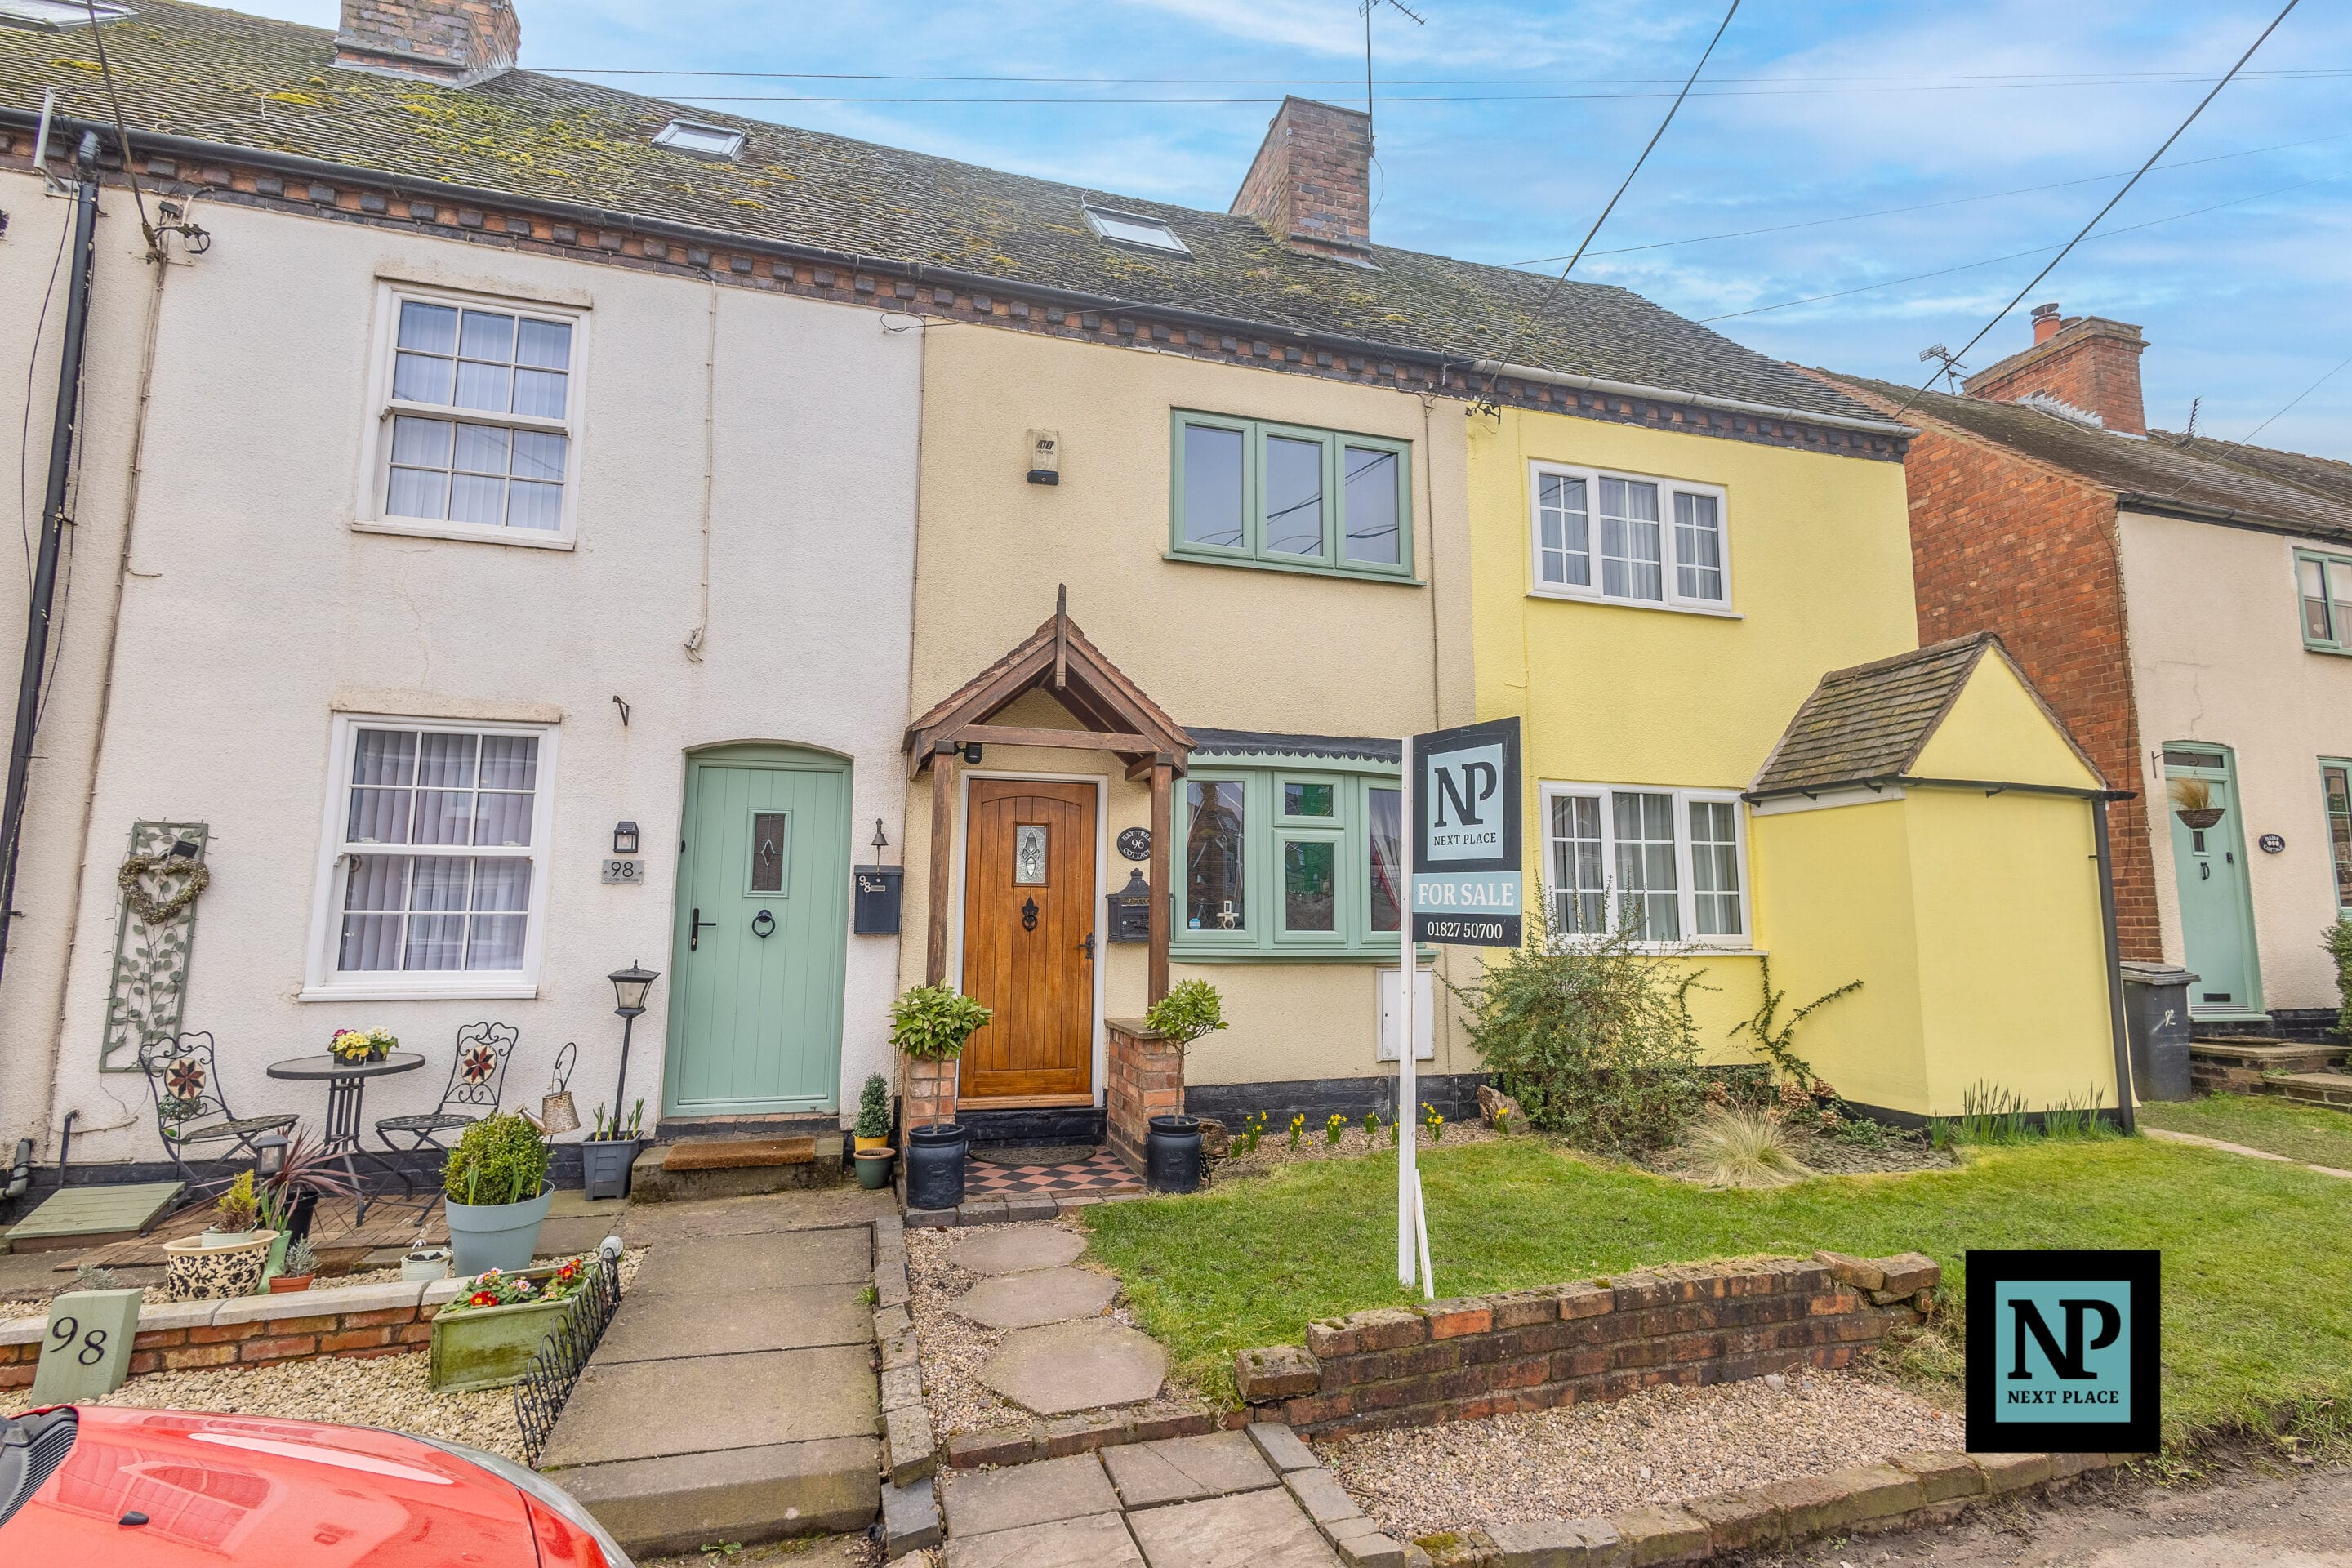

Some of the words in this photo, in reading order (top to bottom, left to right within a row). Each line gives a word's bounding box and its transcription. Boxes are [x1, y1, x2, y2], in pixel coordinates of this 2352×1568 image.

[1434, 761, 1497, 827] NP
[1121, 831, 1134, 841] BAY
[1131, 839, 1144, 849] 96
[1434, 835, 1460, 846] NEXT
[1463, 832, 1496, 844] PLACE
[611, 862, 634, 877] 98
[859, 875, 871, 893] 98
[1418, 884, 1456, 906] FOR
[1461, 883, 1514, 906] SALE
[1428, 921, 1461, 938] 01827
[1463, 923, 1503, 939] 50700
[50, 1316, 107, 1365] 98
